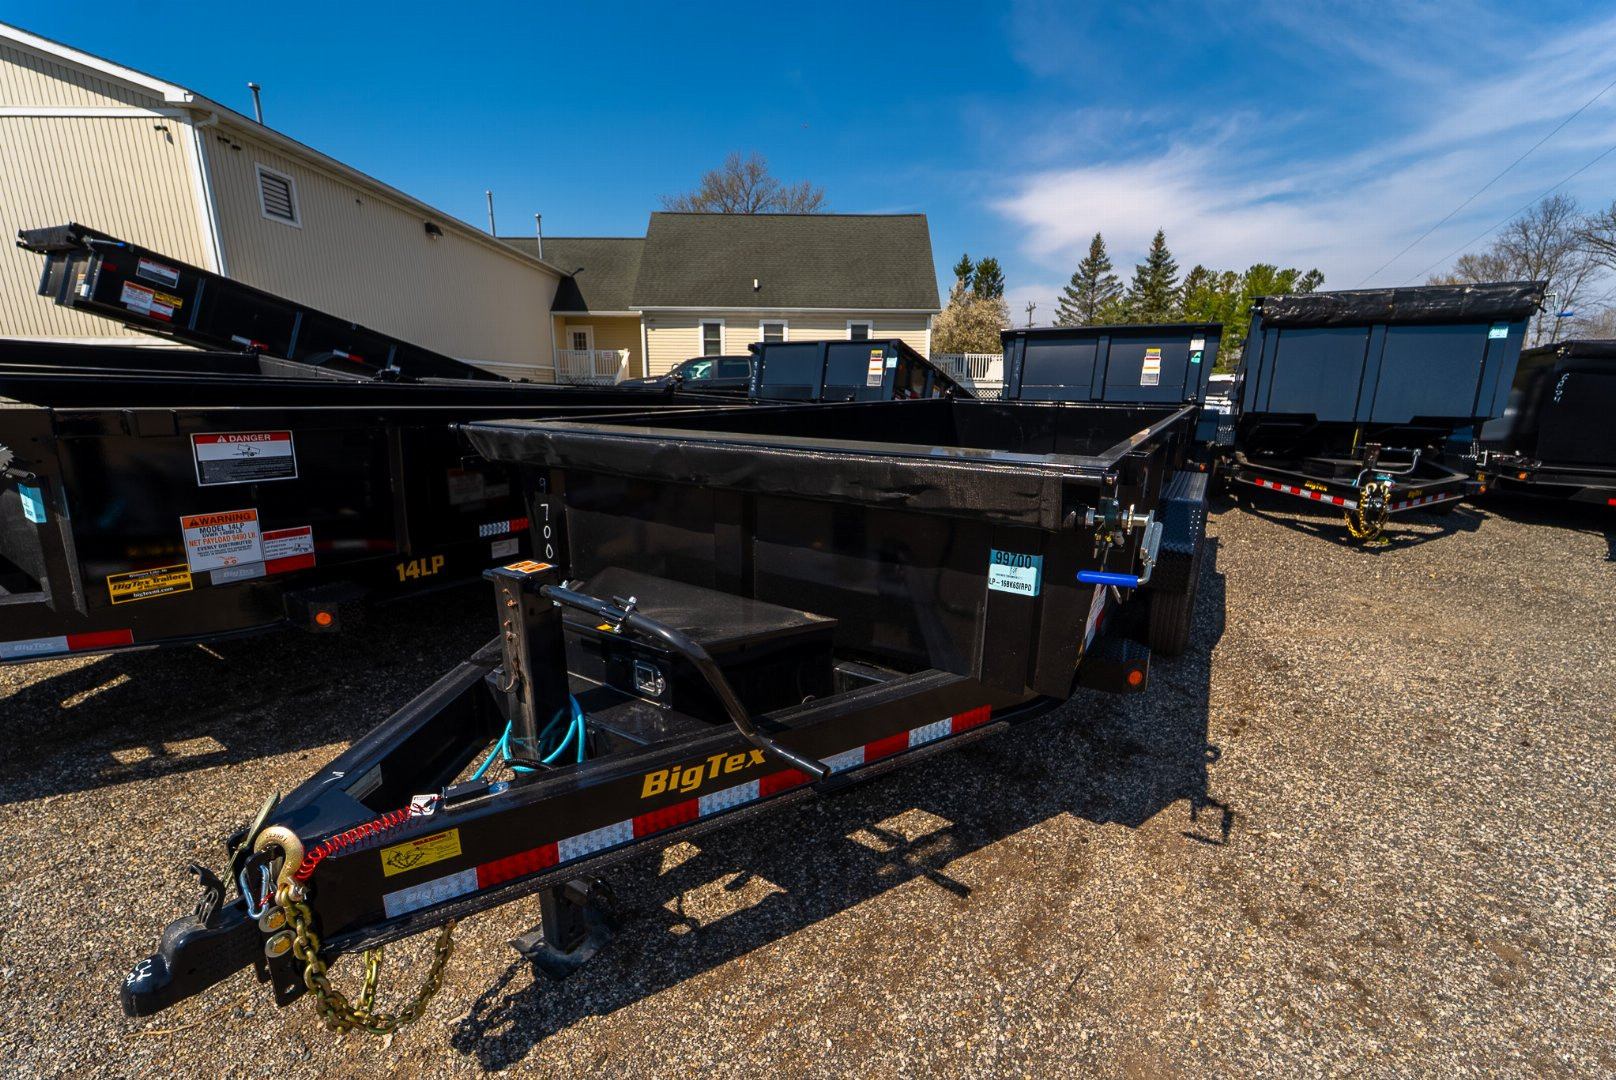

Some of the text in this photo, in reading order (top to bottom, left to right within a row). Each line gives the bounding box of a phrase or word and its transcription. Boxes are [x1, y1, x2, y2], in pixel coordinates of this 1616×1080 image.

[228, 433, 271, 443] DANGER
[200, 512, 251, 525] WARNING
[199, 522, 245, 534] MODEL 14LP
[188, 539, 201, 547] NET
[202, 536, 231, 545] PAYLOAD
[995, 551, 1032, 569] 99700
[396, 555, 444, 582] 14LP
[640, 748, 767, 799] BigTex
